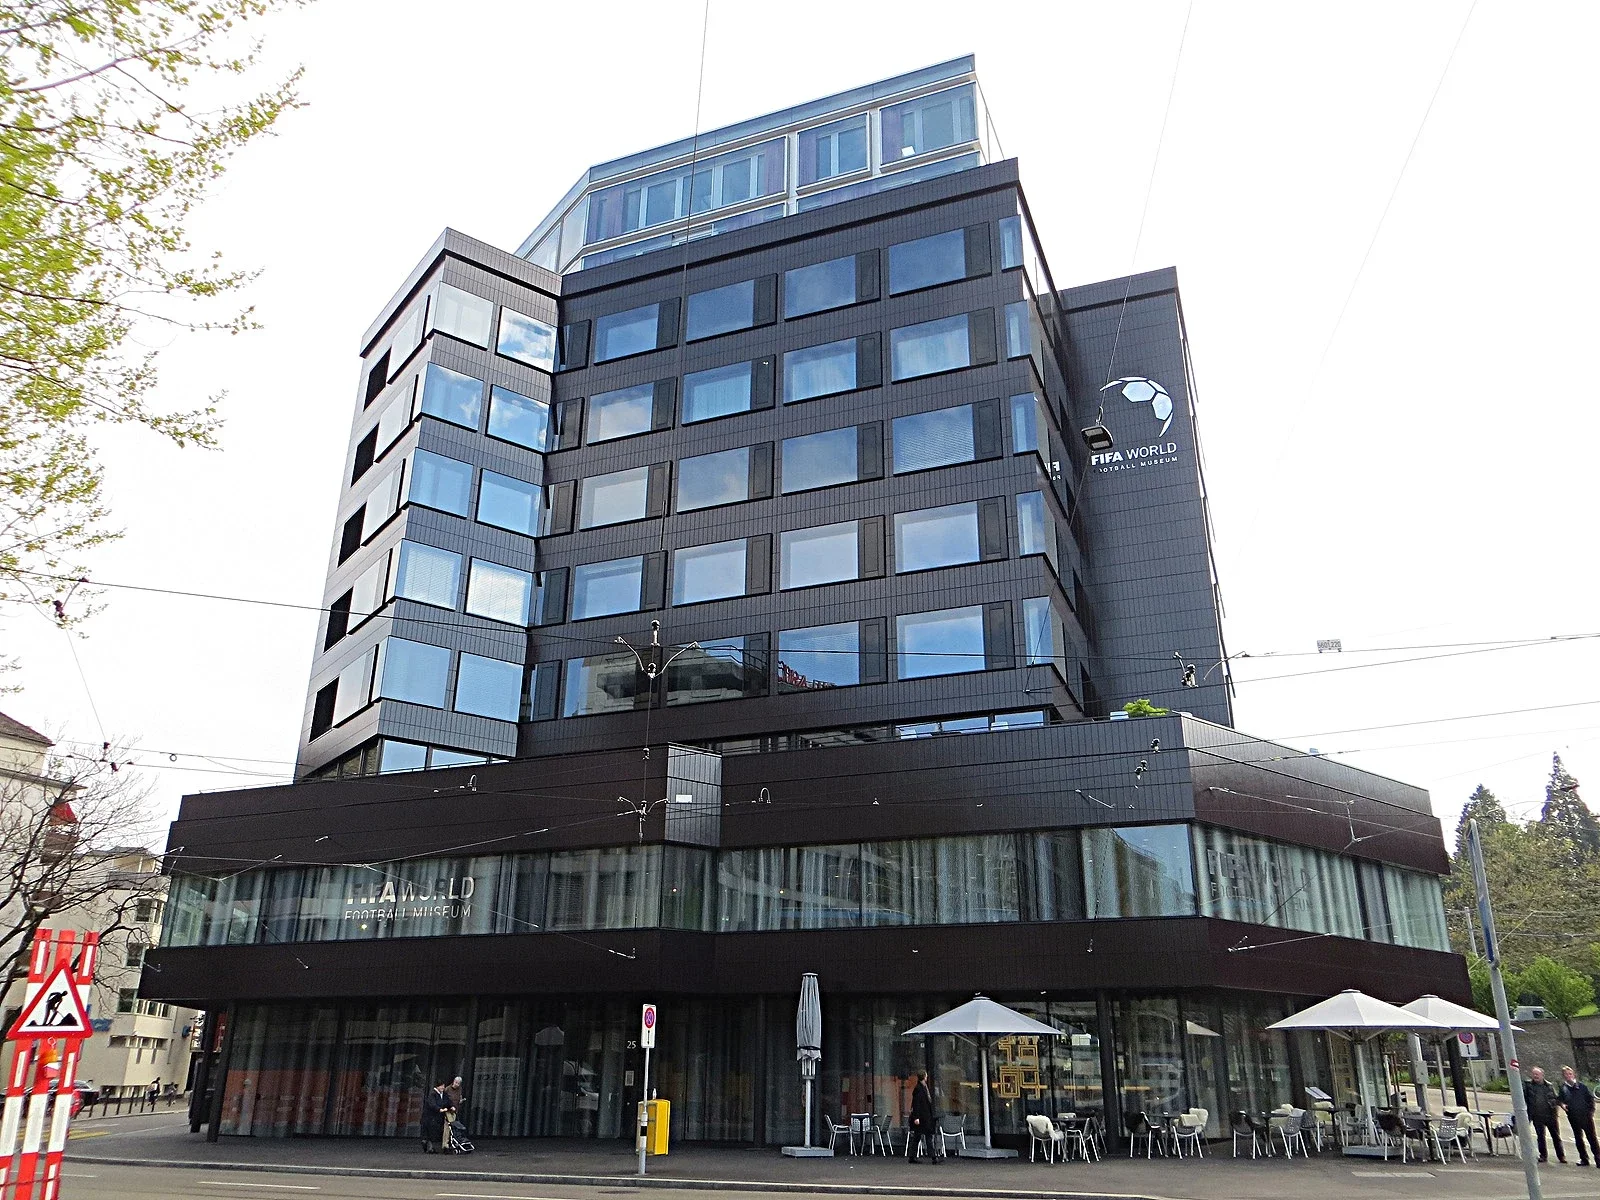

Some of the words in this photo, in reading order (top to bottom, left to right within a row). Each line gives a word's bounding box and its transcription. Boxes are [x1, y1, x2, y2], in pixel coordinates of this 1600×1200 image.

[1091, 451, 1124, 466] FIFA
[1126, 442, 1177, 460] WORLD
[1097, 462, 1136, 474] OTBALL
[1140, 456, 1178, 467] MUSEUM
[402, 876, 475, 901] WORLD
[344, 907, 409, 922] FOOTBALL
[412, 904, 471, 919] MUSEUM
[626, 1041, 637, 1049] 25
